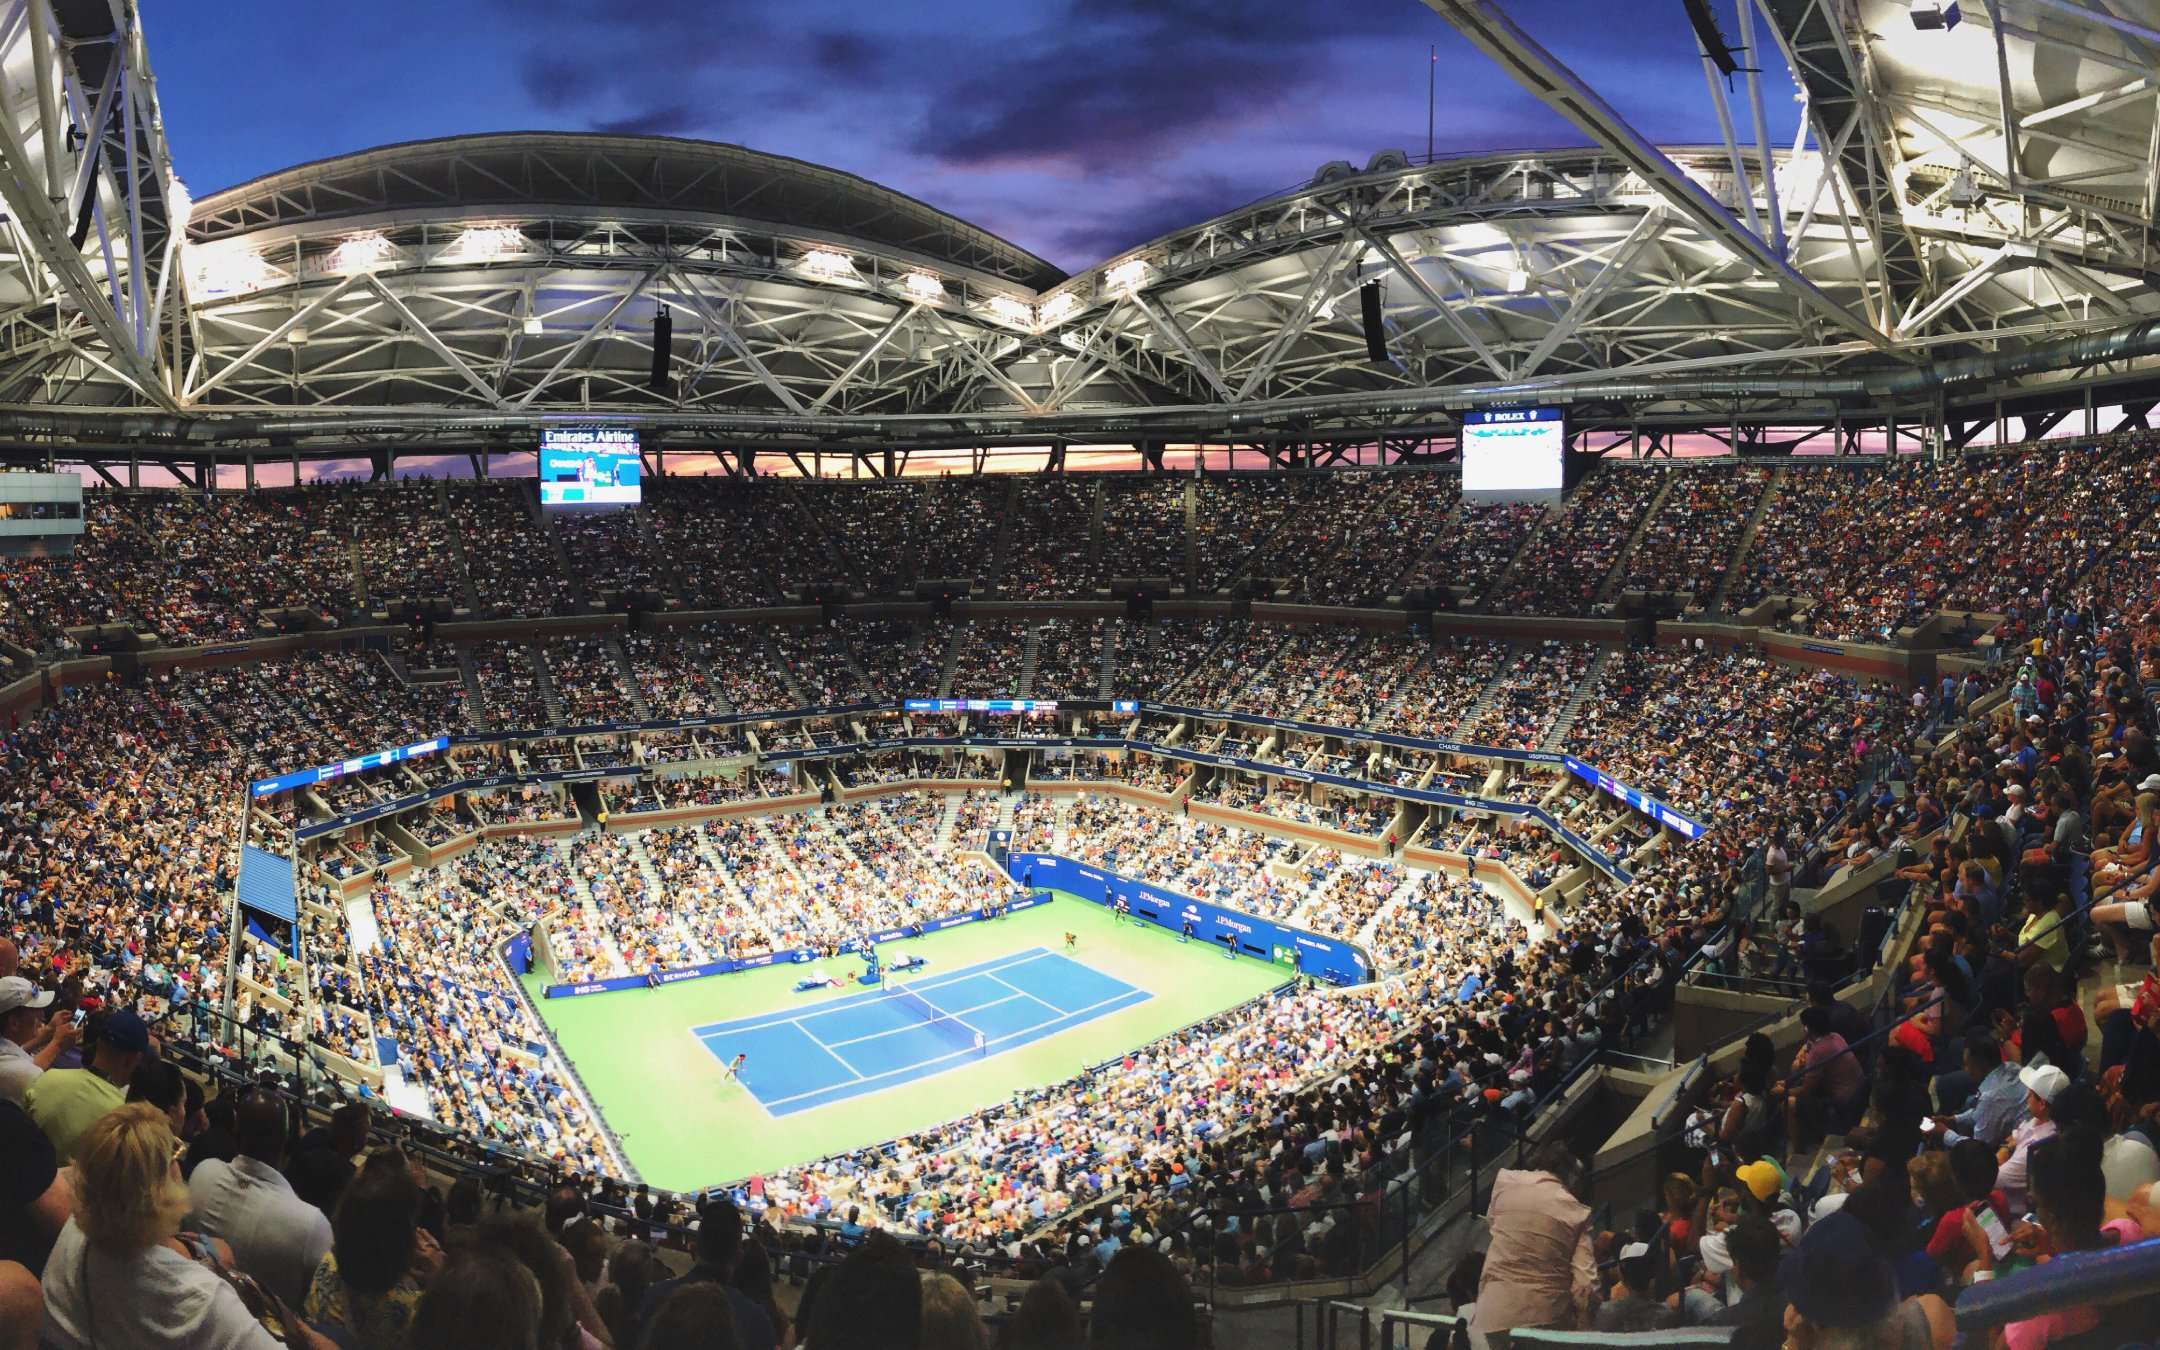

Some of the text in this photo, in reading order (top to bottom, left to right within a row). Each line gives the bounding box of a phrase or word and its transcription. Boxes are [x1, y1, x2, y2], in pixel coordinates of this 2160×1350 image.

[1494, 412, 1525, 421] ROLEX
[545, 431, 635, 443] Emirates Airline
[1438, 743, 1461, 752] CHASE
[663, 970, 701, 982] BERMUDA
